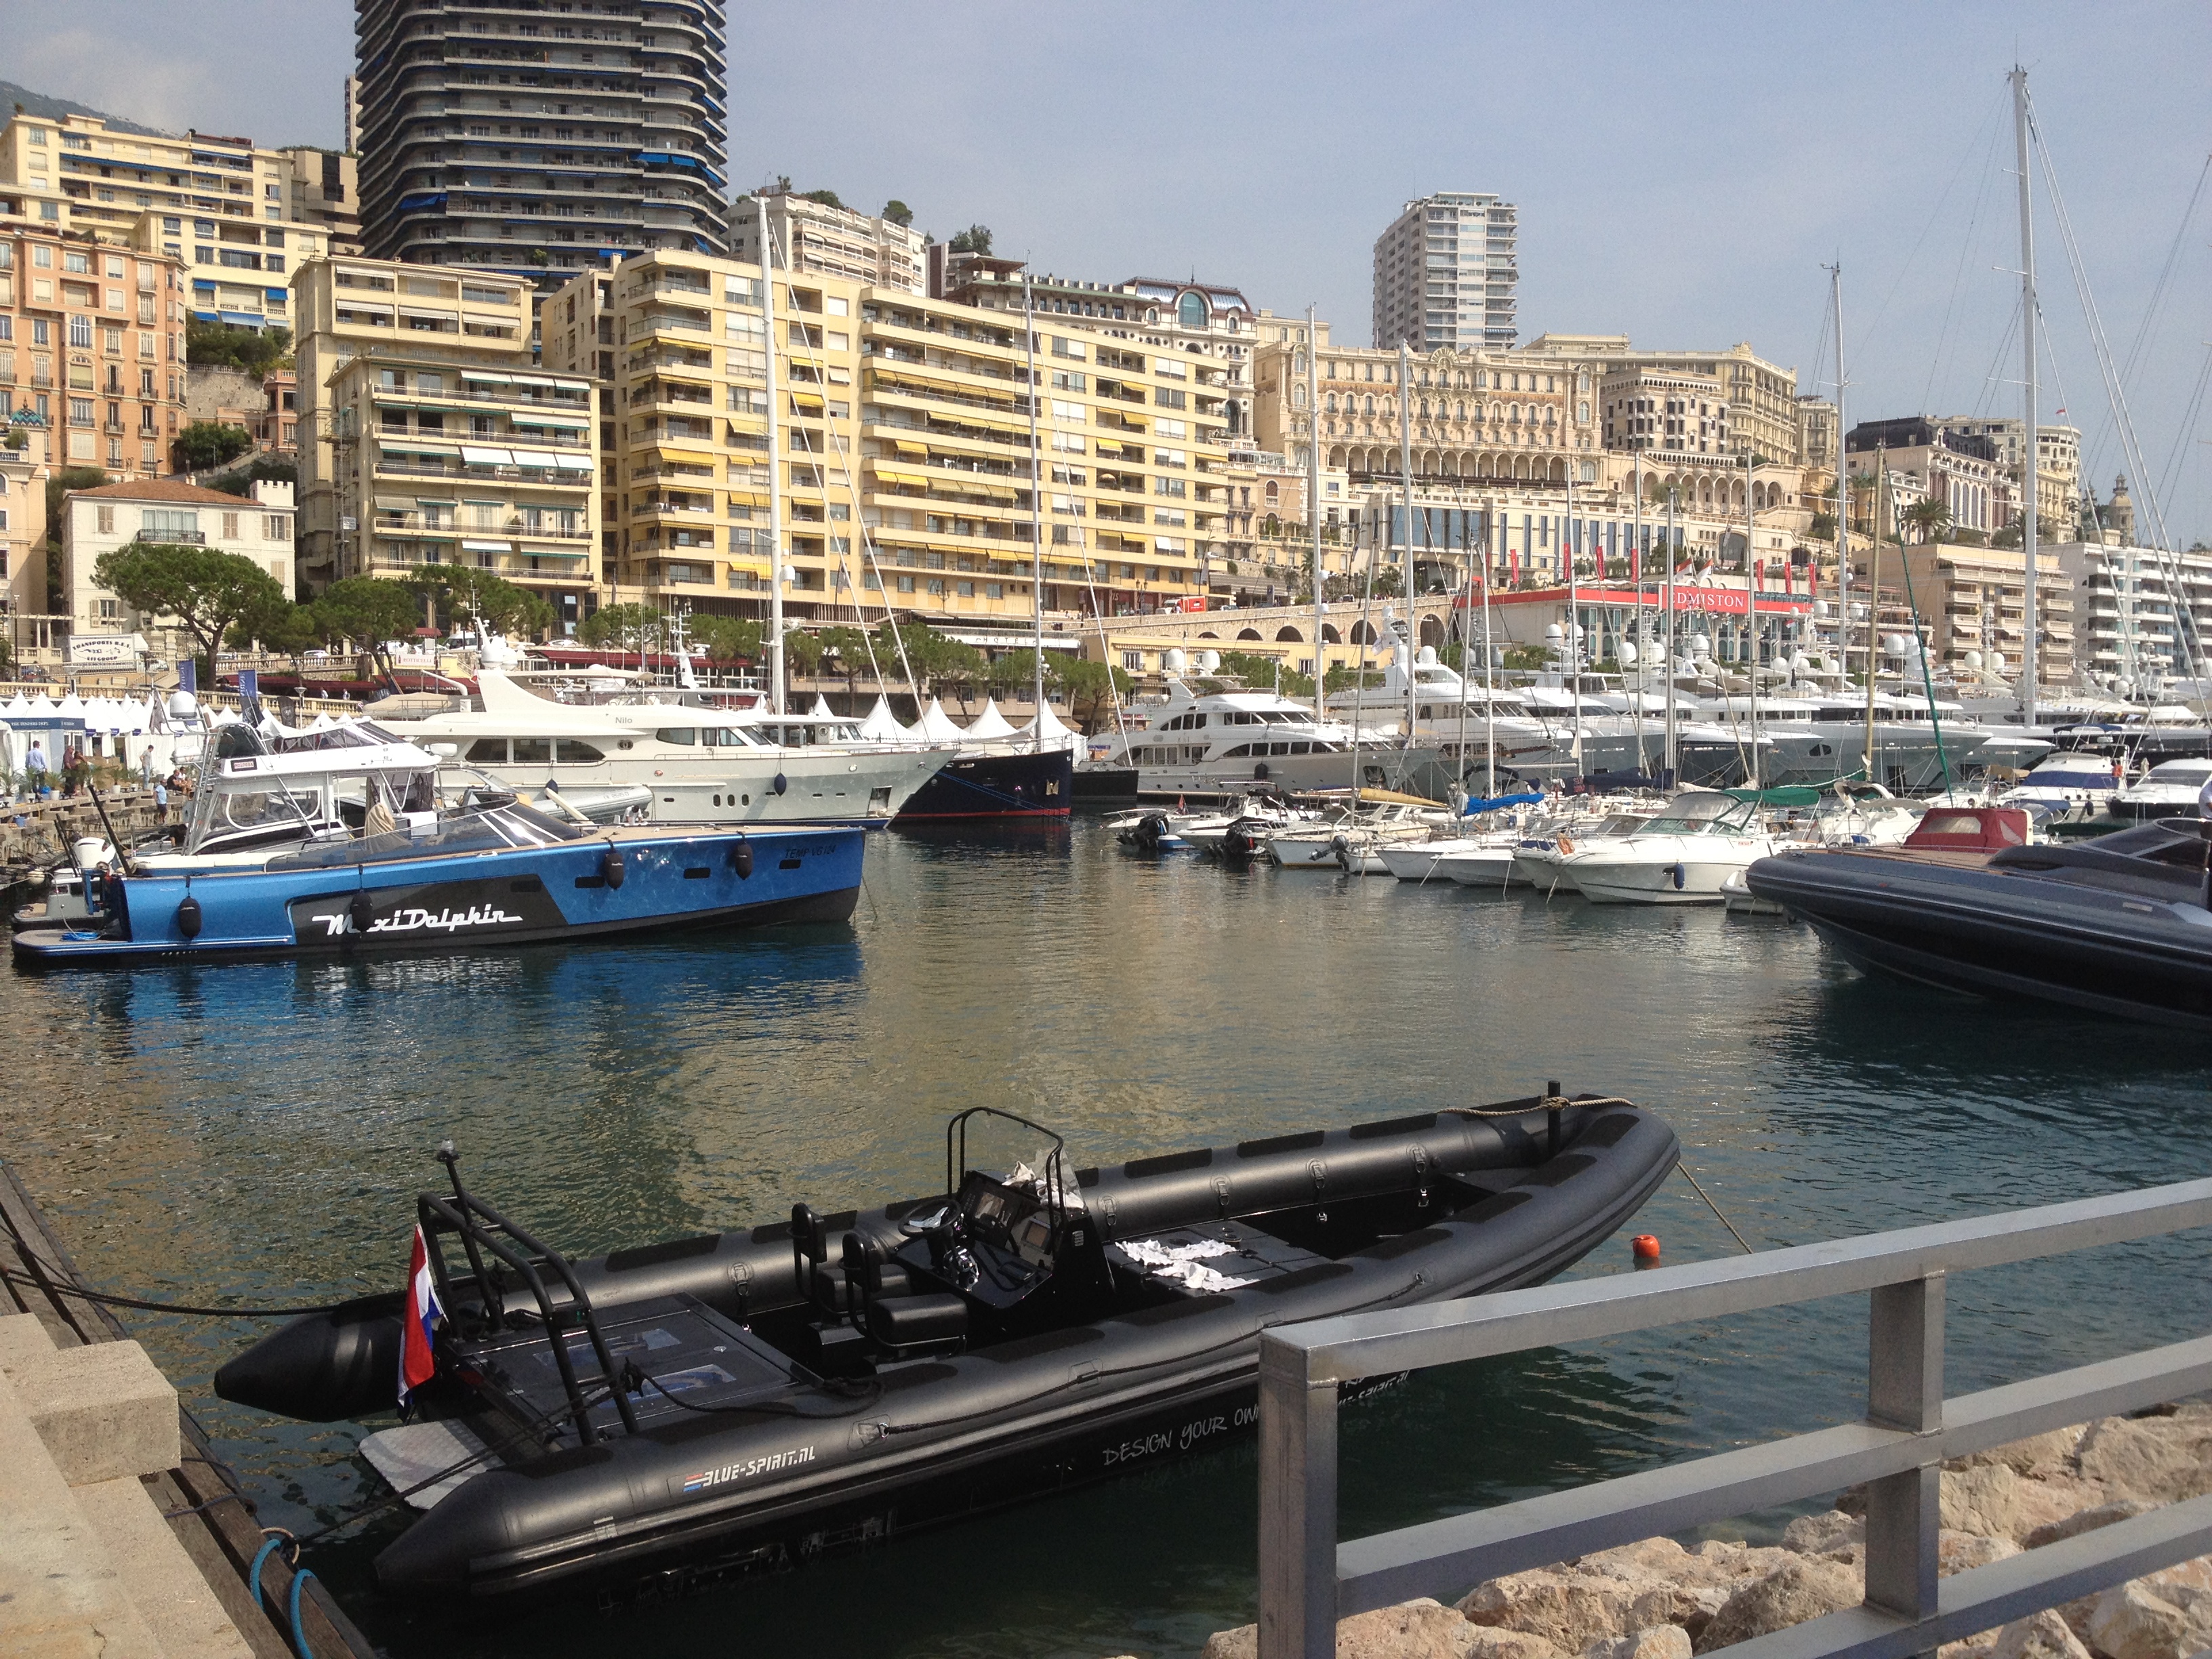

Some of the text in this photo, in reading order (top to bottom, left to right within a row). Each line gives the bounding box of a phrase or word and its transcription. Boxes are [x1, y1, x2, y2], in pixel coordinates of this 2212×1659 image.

[1671, 591, 1744, 607] DMISTON
[983, 637, 1028, 646] HOTEL
[785, 848, 810, 859] TEMP
[312, 903, 523, 935] MxiDolphin
[1103, 1430, 1172, 1466] DESIGN
[1179, 1416, 1228, 1450] YOUR
